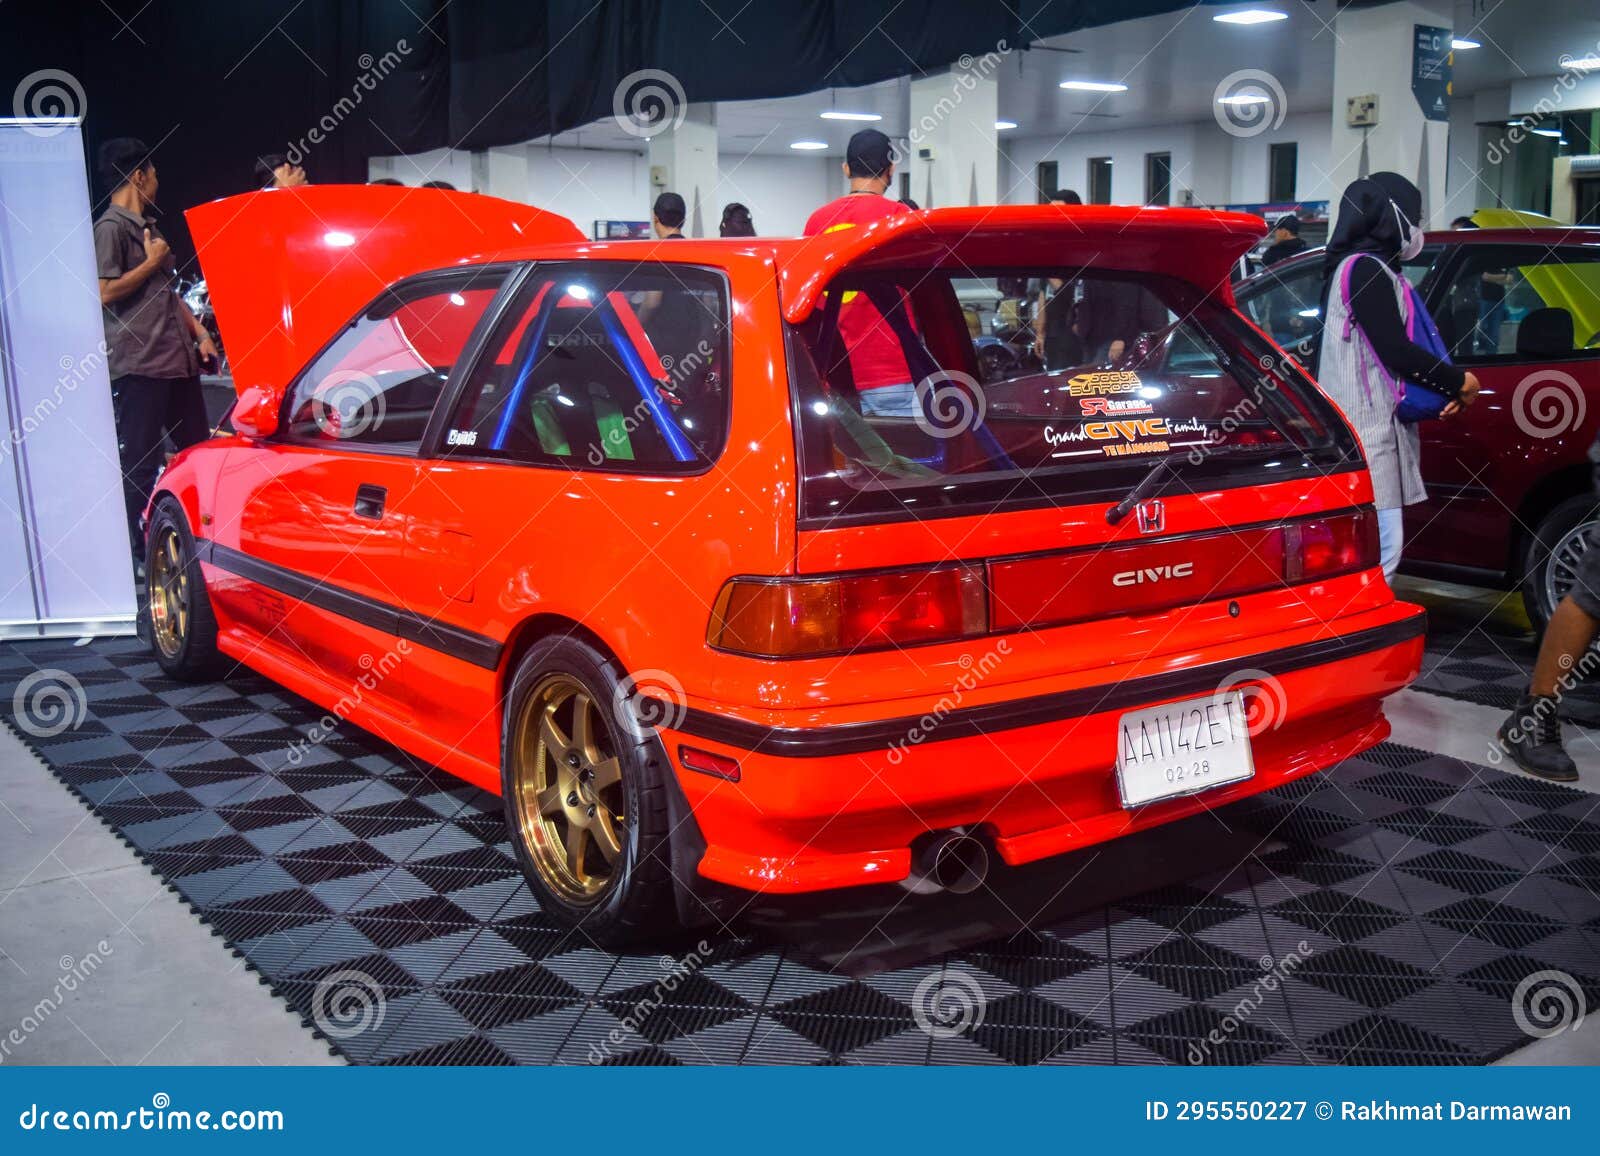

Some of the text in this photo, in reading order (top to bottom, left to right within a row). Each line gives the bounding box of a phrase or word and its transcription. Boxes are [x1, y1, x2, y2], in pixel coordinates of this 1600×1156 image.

[1044, 417, 1208, 446] Grand CIVIC Family
[1112, 562, 1193, 586] CIVIC
[1123, 701, 1235, 766] AA1142ET
